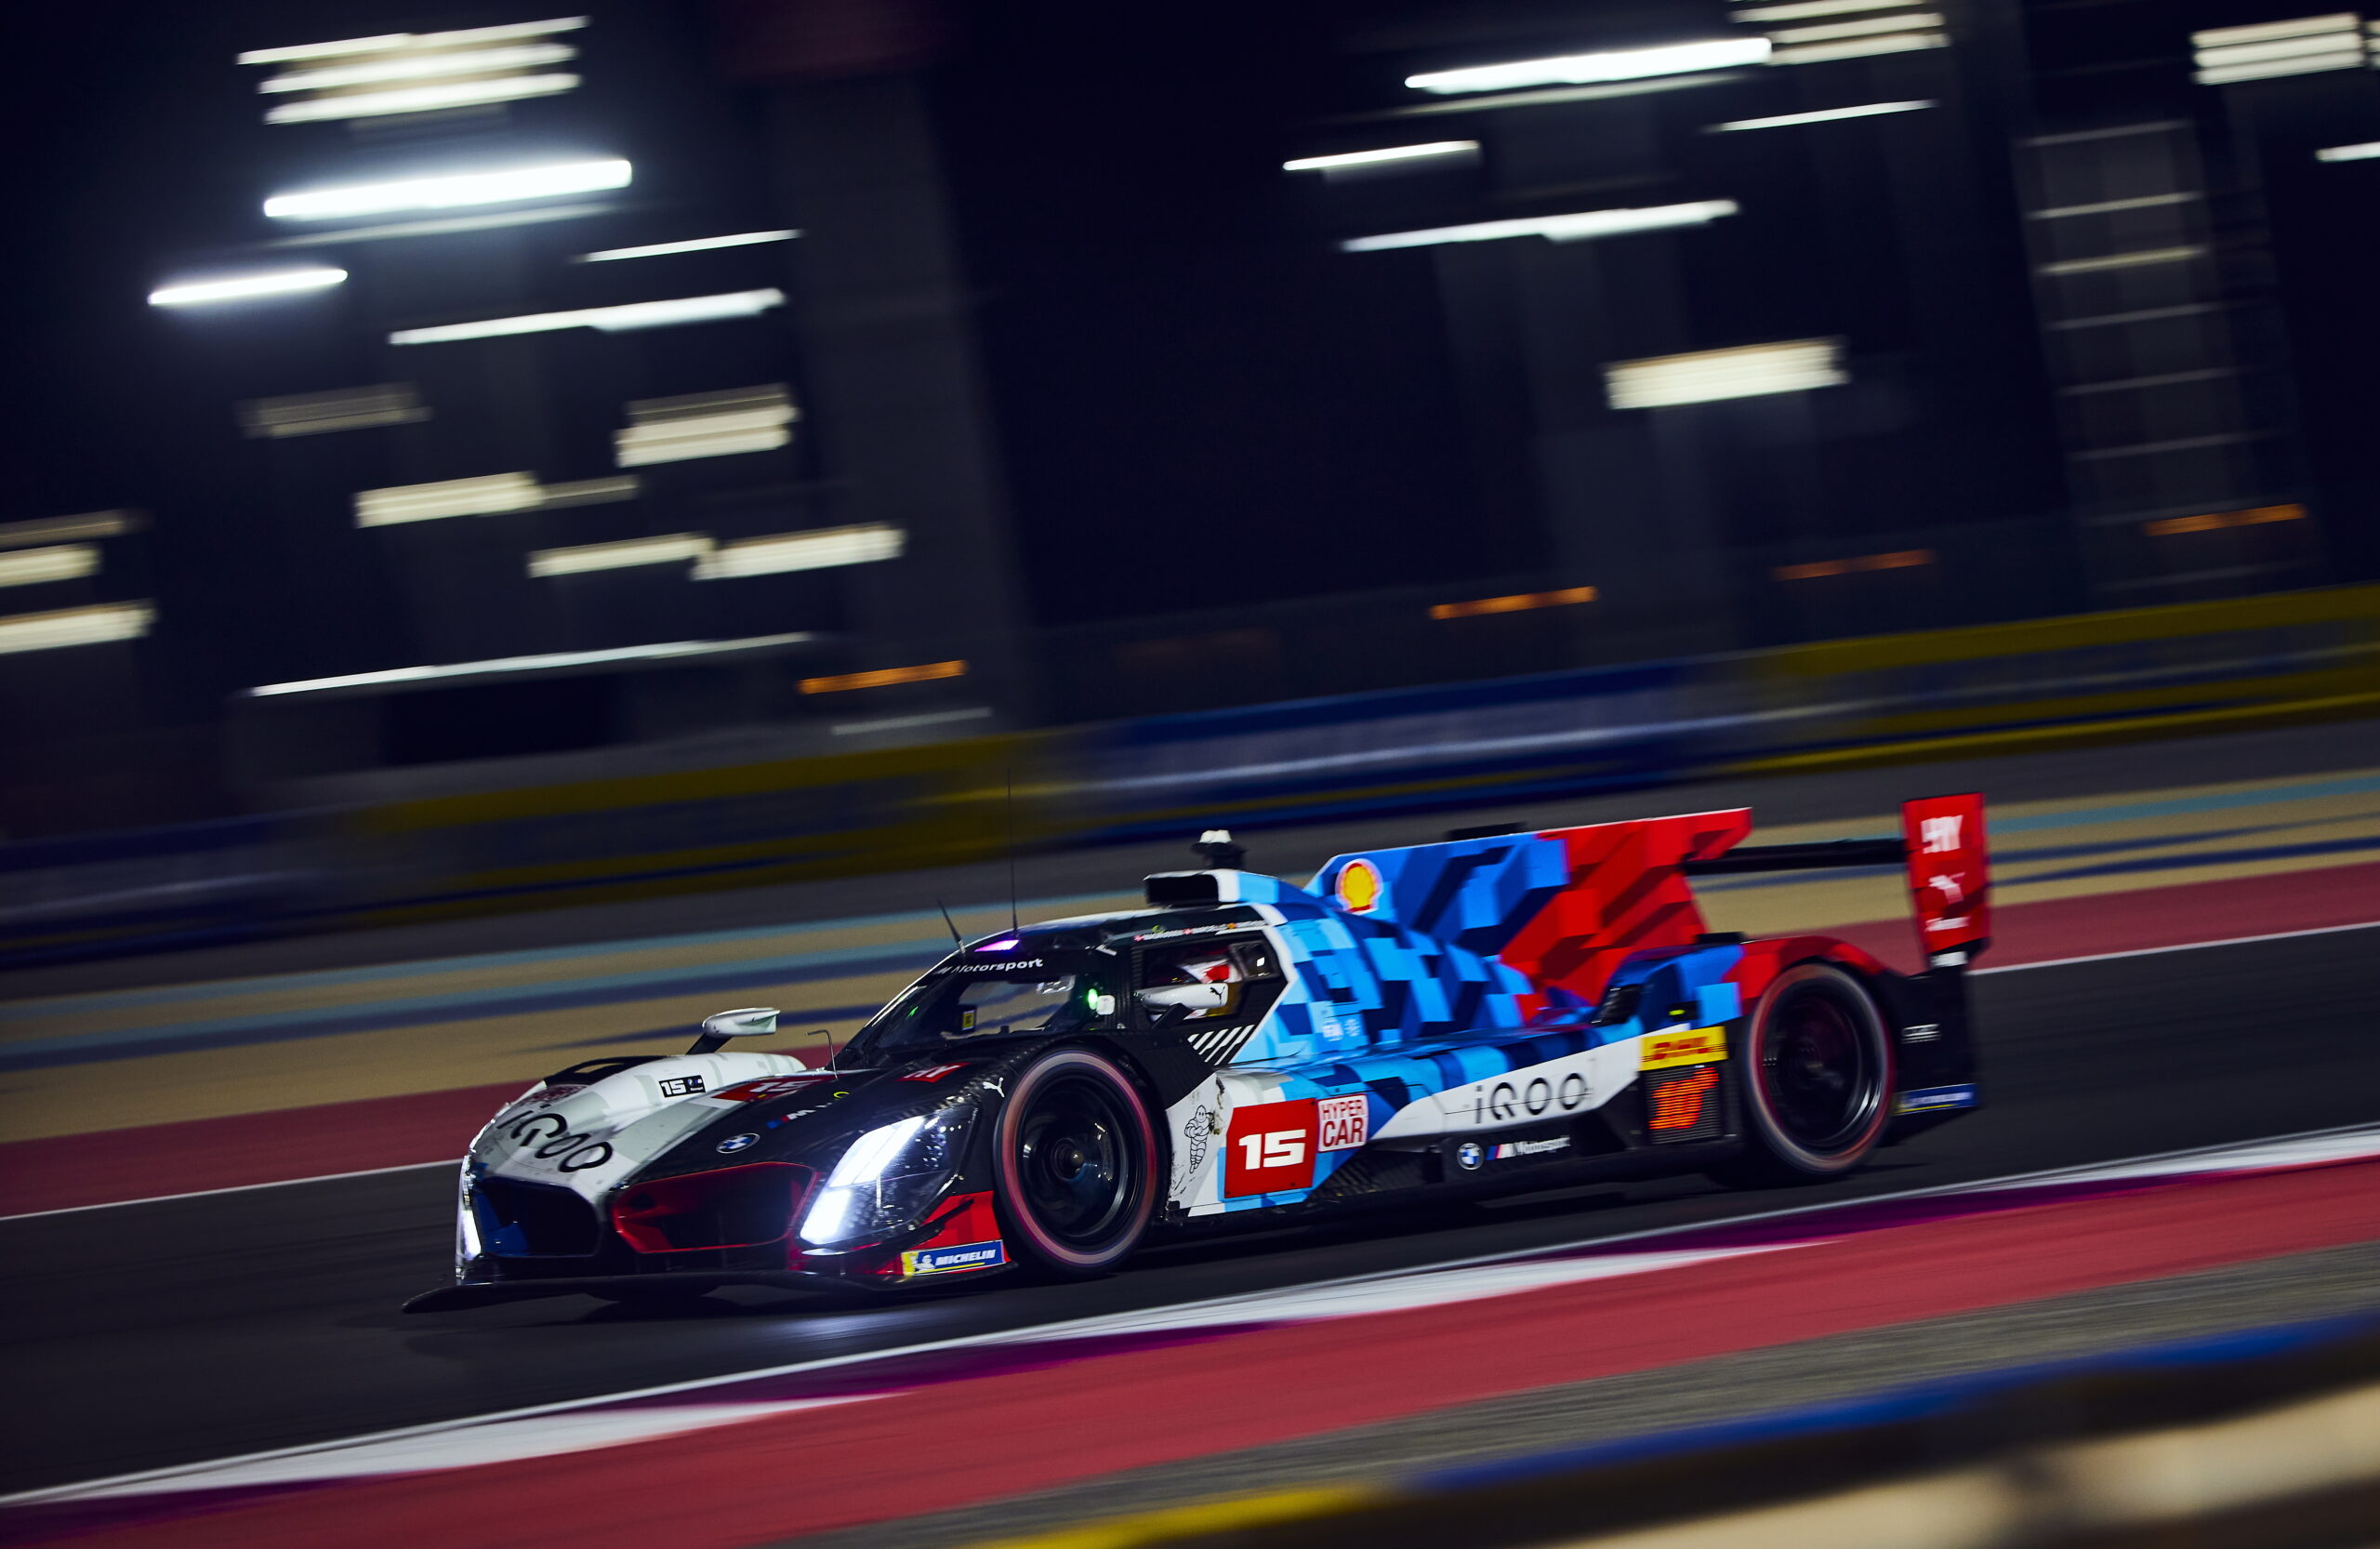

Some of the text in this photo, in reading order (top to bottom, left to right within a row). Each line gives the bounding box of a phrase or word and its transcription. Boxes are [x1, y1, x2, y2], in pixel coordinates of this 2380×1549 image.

[951, 958, 1043, 973] Motorsport
[660, 1079, 687, 1096] 15
[1321, 1099, 1366, 1120] HYPER
[1323, 1117, 1363, 1147] CAR
[1238, 1129, 1306, 1171] 15
[935, 1249, 997, 1266] MICHELIN
